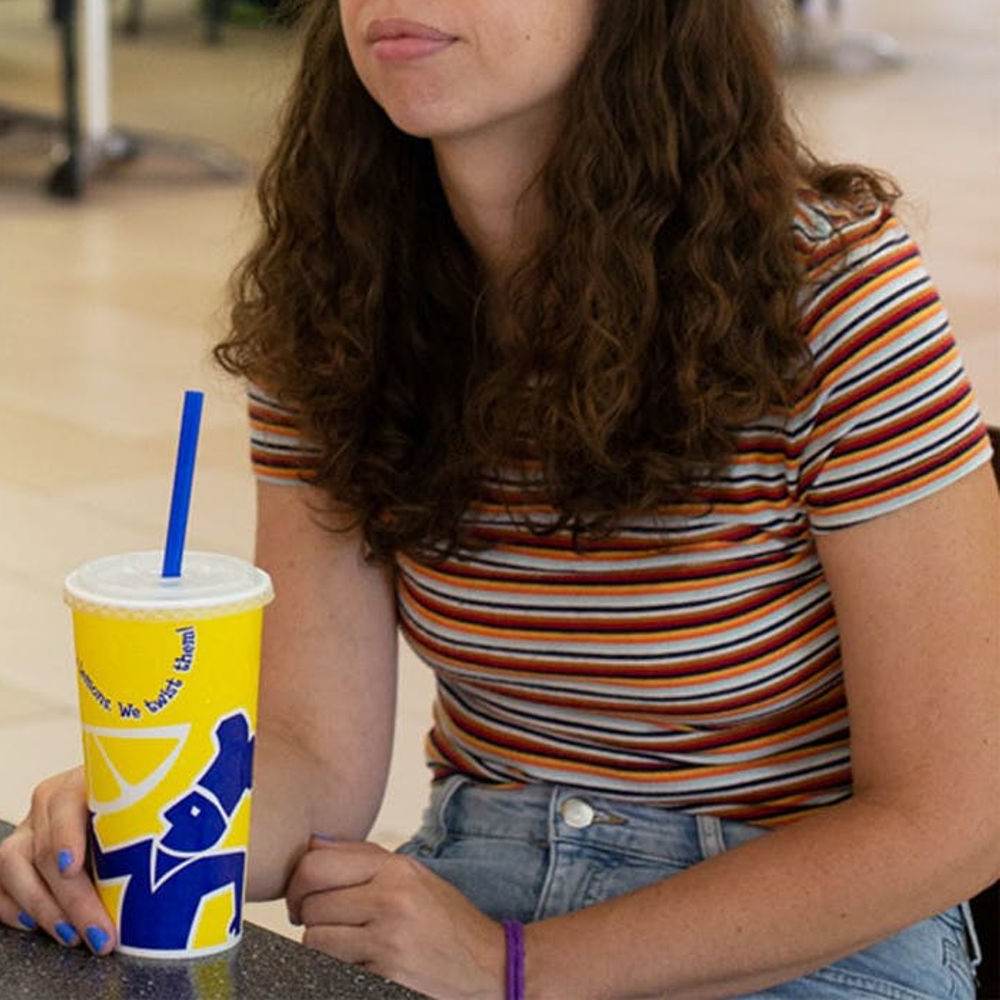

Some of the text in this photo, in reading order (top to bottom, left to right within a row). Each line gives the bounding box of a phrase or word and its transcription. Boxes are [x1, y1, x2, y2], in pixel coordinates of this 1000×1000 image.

[117, 701, 141, 718] We
[143, 677, 183, 713] twist
[173, 625, 195, 671] them!
